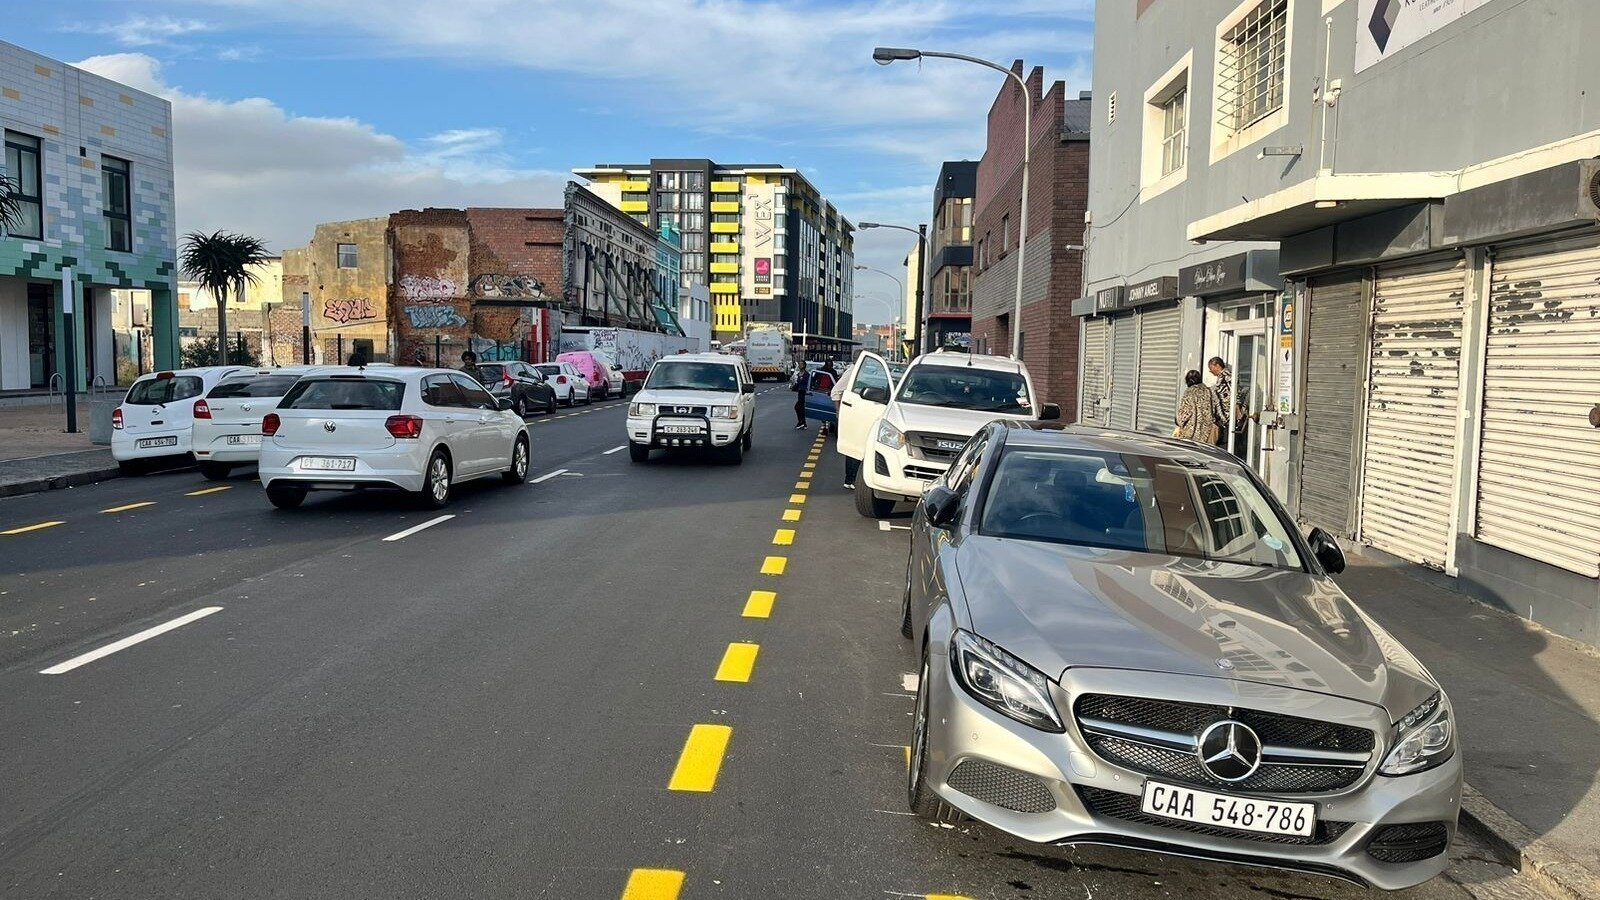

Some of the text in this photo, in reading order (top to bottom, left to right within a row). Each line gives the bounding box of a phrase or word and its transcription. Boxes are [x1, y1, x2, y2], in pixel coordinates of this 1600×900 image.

[1145, 282, 1160, 297] ANGEL
[938, 441, 964, 450] ISUZ
[1152, 786, 1306, 832] CAA 548-786
